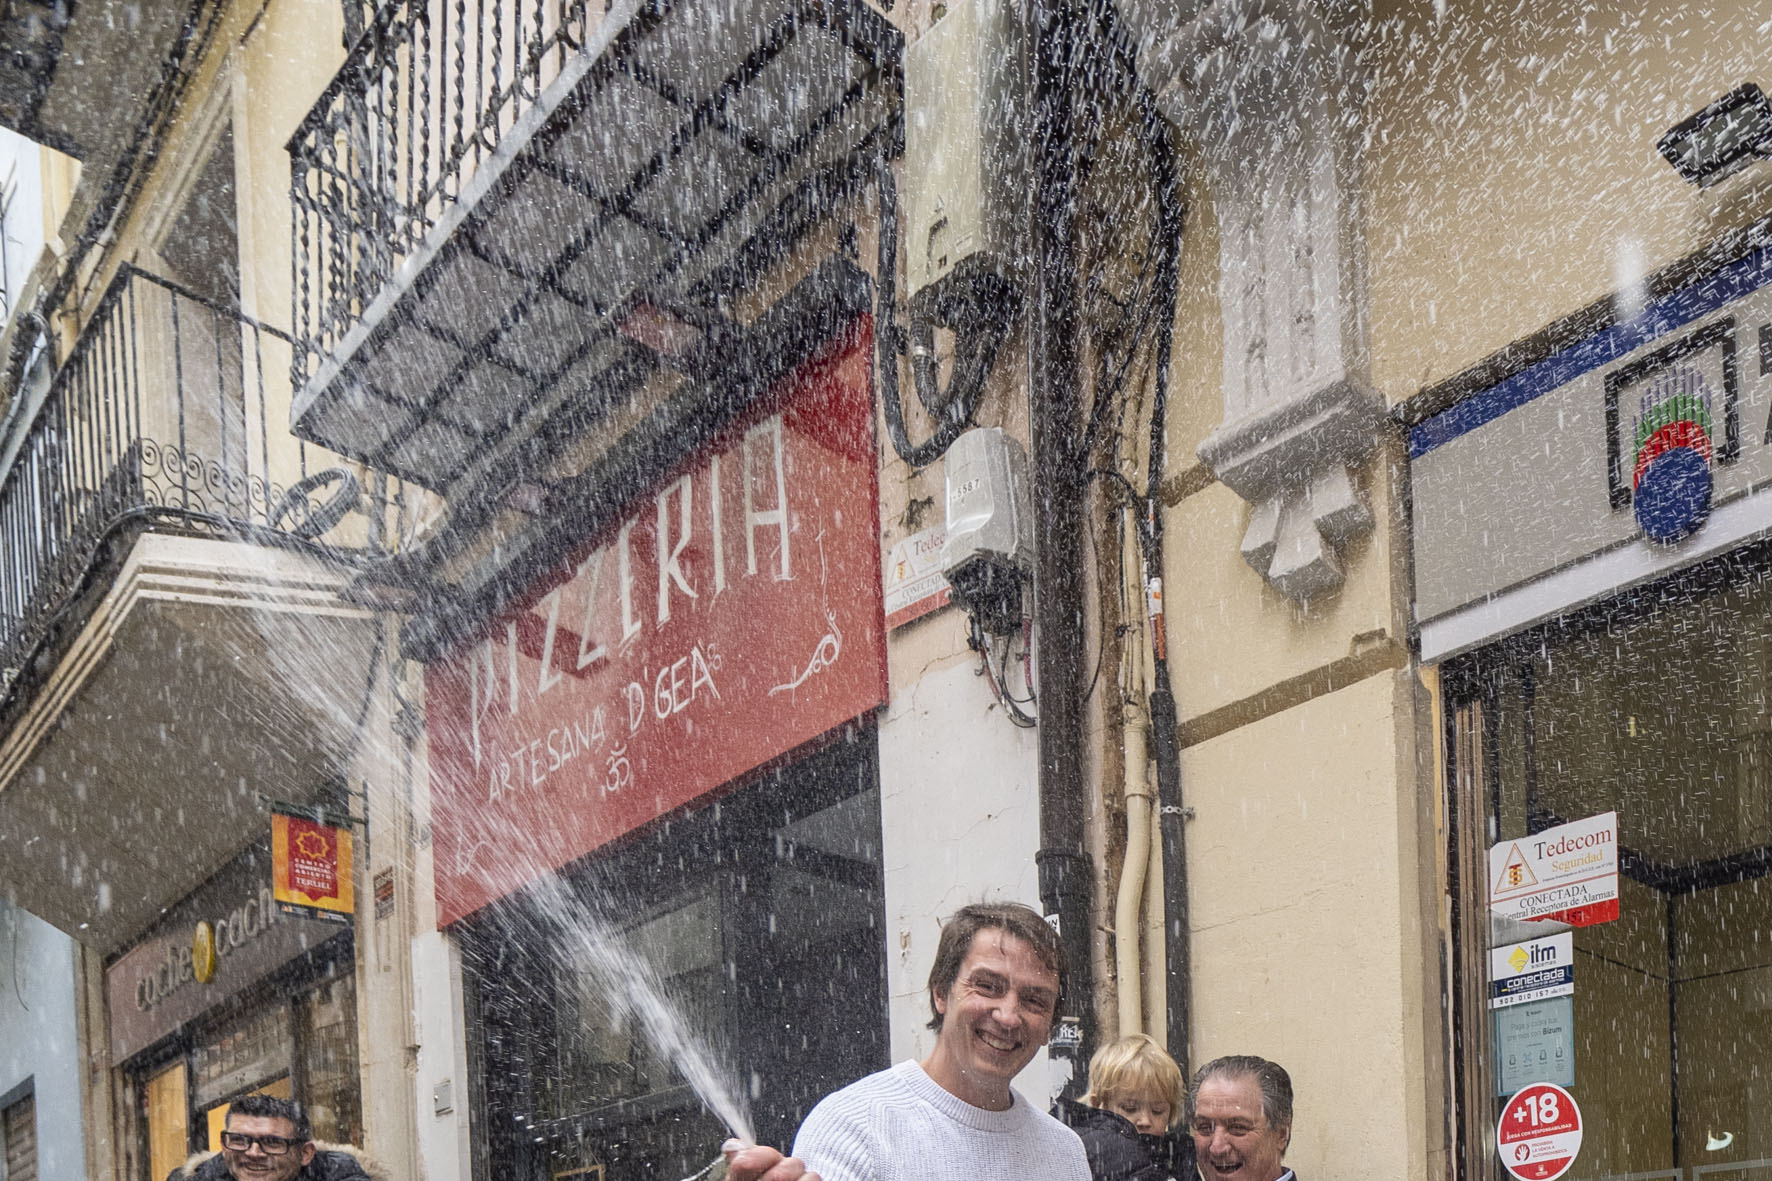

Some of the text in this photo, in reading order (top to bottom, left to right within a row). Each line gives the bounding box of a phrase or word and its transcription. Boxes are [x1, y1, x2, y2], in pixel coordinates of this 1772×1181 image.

[468, 415, 792, 772] PIZZERIA
[488, 709, 607, 803] ARTESANA
[1534, 829, 1612, 860] Tedecom
[1552, 849, 1604, 873] Seguridad
[296, 876, 331, 889] TERUEL
[1520, 884, 1588, 909] CONECTADA
[1530, 899, 1569, 916] Receptora
[1570, 897, 1579, 906] de
[1581, 890, 1615, 904] Alarmas
[1530, 944, 1556, 964] itm
[1507, 969, 1564, 988] conectada
[1518, 993, 1532, 1001] 010
[1535, 989, 1549, 998] 157
[1542, 1026, 1562, 1036] Bizum
[1513, 1092, 1560, 1127] +18
